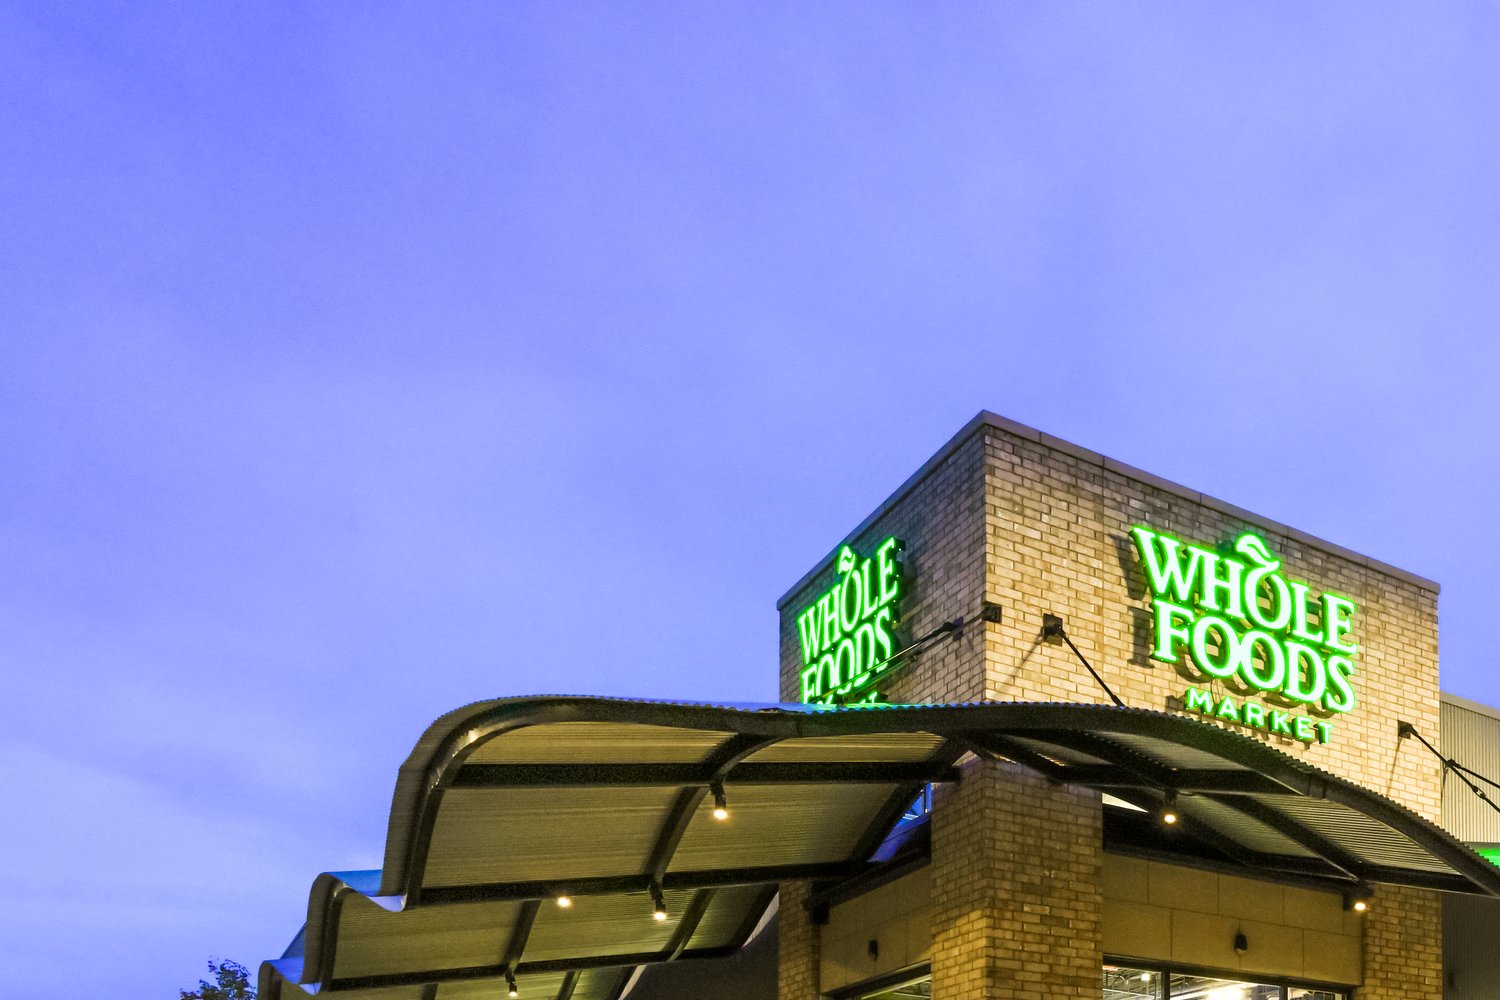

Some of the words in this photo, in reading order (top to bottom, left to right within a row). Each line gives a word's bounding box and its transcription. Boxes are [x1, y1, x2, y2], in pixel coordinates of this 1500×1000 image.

[797, 536, 899, 665] WHOLE
[1131, 526, 1359, 655] WHOLE
[800, 606, 892, 705] FOODS
[1151, 599, 1357, 714] FOODS
[1186, 687, 1335, 745] MARKET
